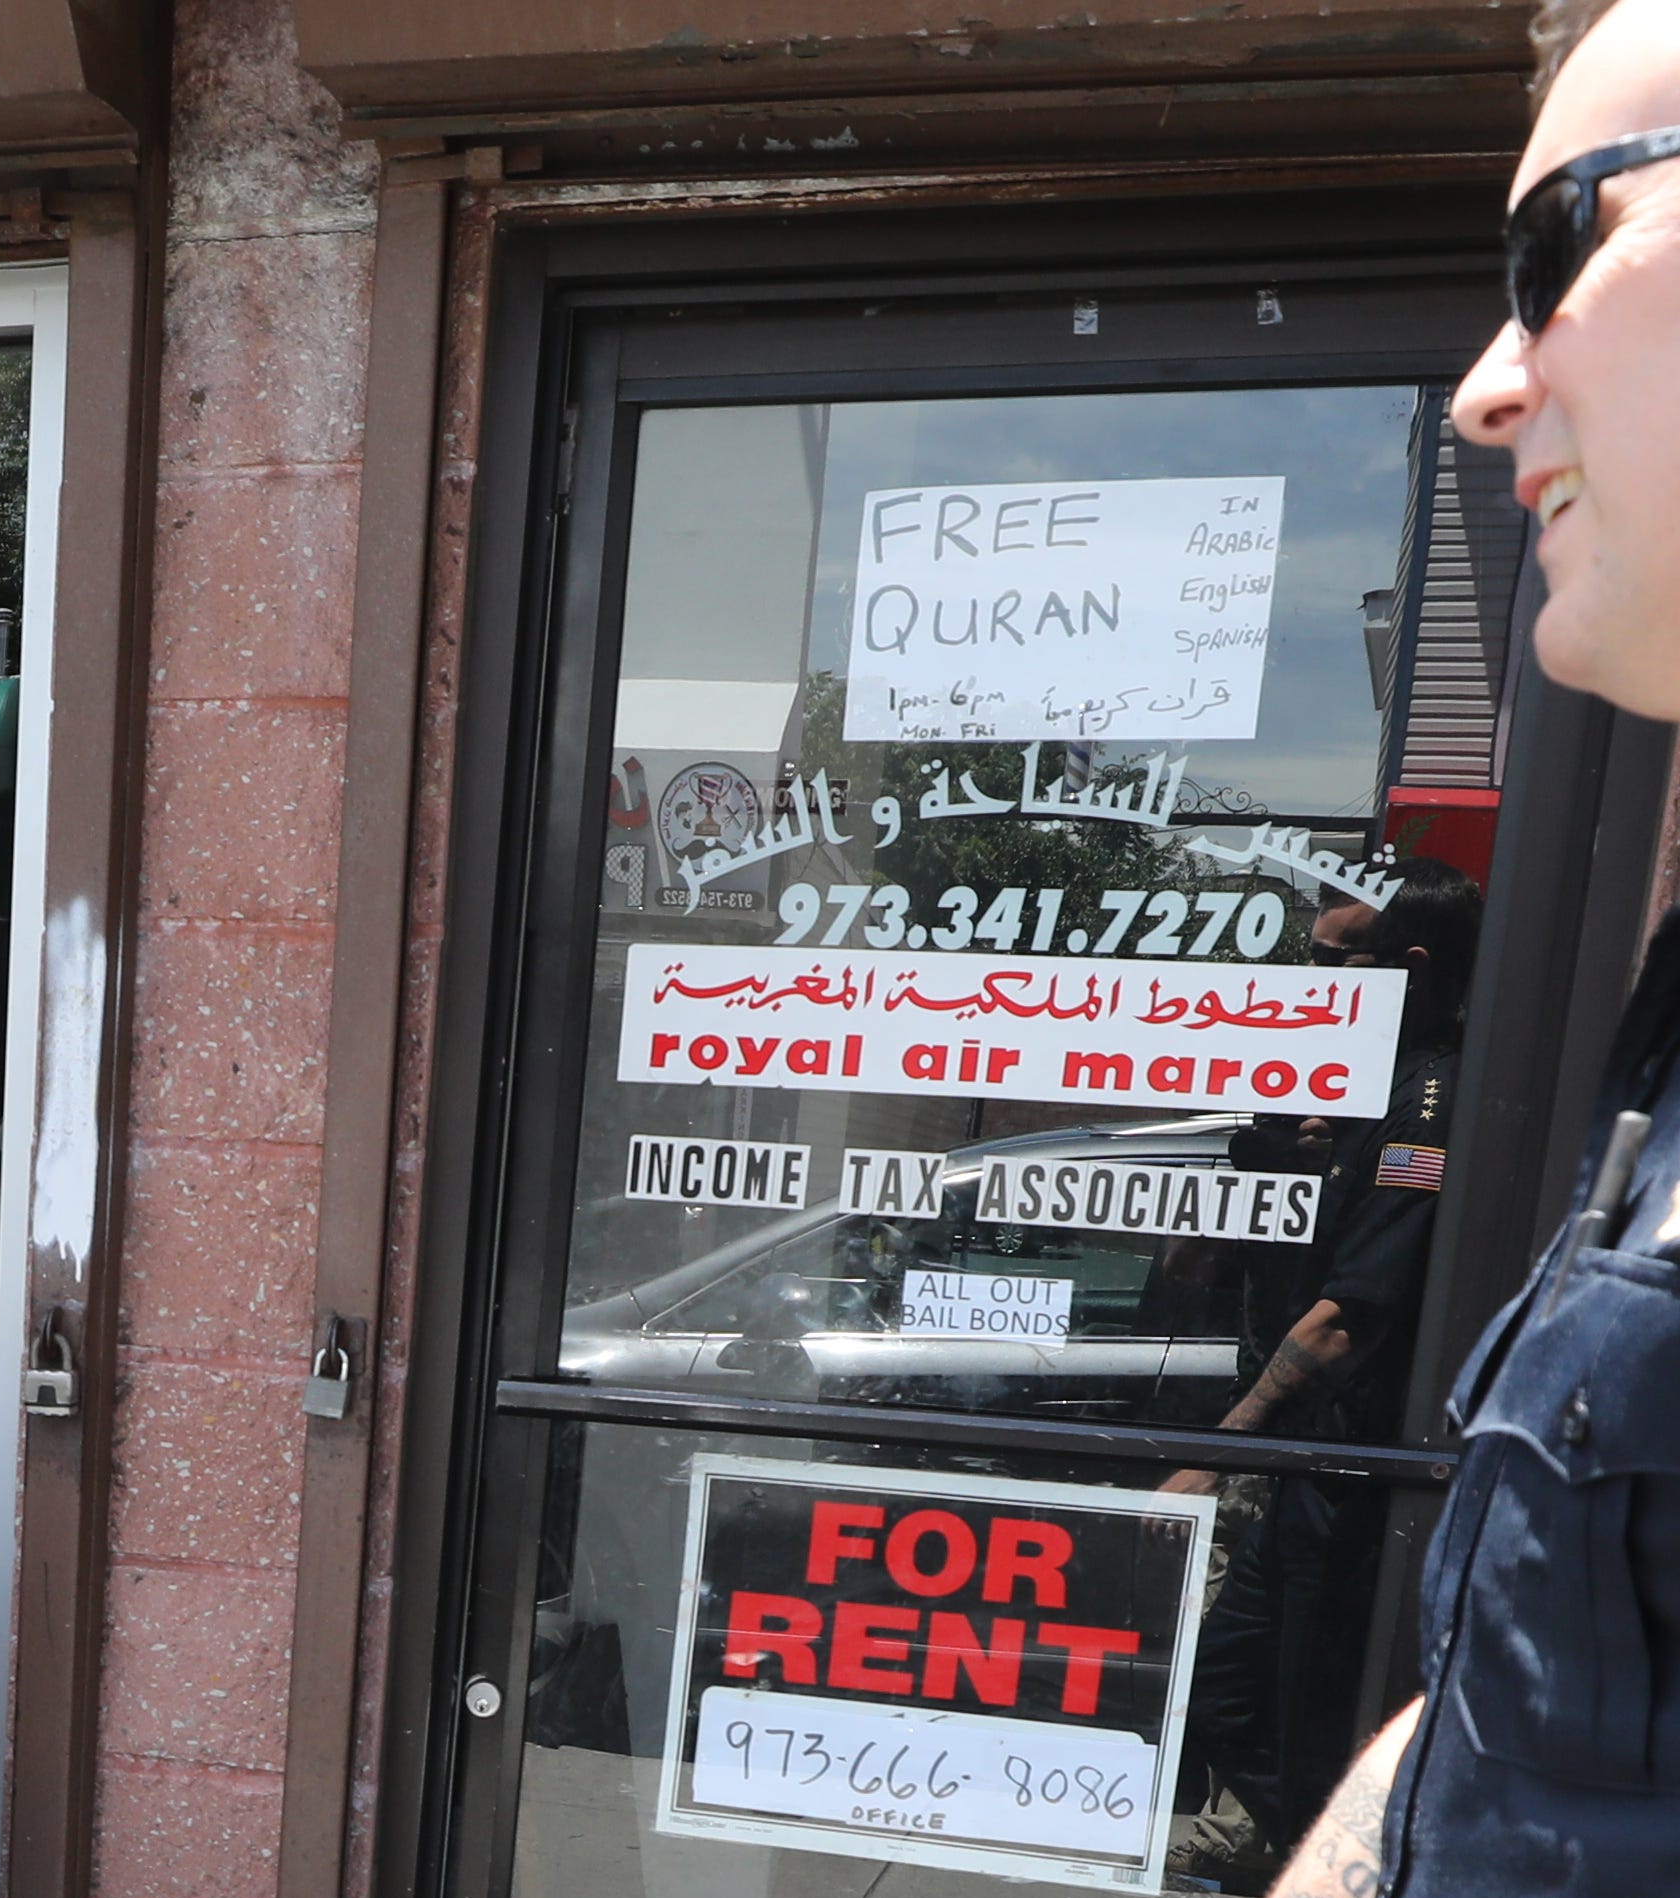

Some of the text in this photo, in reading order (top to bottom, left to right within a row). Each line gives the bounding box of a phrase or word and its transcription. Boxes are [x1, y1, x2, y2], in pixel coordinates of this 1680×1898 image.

[872, 492, 1100, 564] FREE
[1220, 496, 1259, 515] IN
[865, 583, 1121, 655] QURAN
[871, 796, 901, 848] و
[772, 883, 1285, 958] 973.341.7270
[653, 961, 1362, 1031] الخطوط الملكية المغربية
[649, 1030, 1351, 1100] royal air maroc
[630, 1140, 1315, 1239] INCOME TAX ASSOCIATES
[900, 1304, 1070, 1337] BAIL BONDS
[917, 1273, 1058, 1306] ALL OUT
[804, 1500, 1073, 1609] FOR
[722, 1590, 1140, 1716] RENT
[851, 1806, 946, 1830] OFFICE
